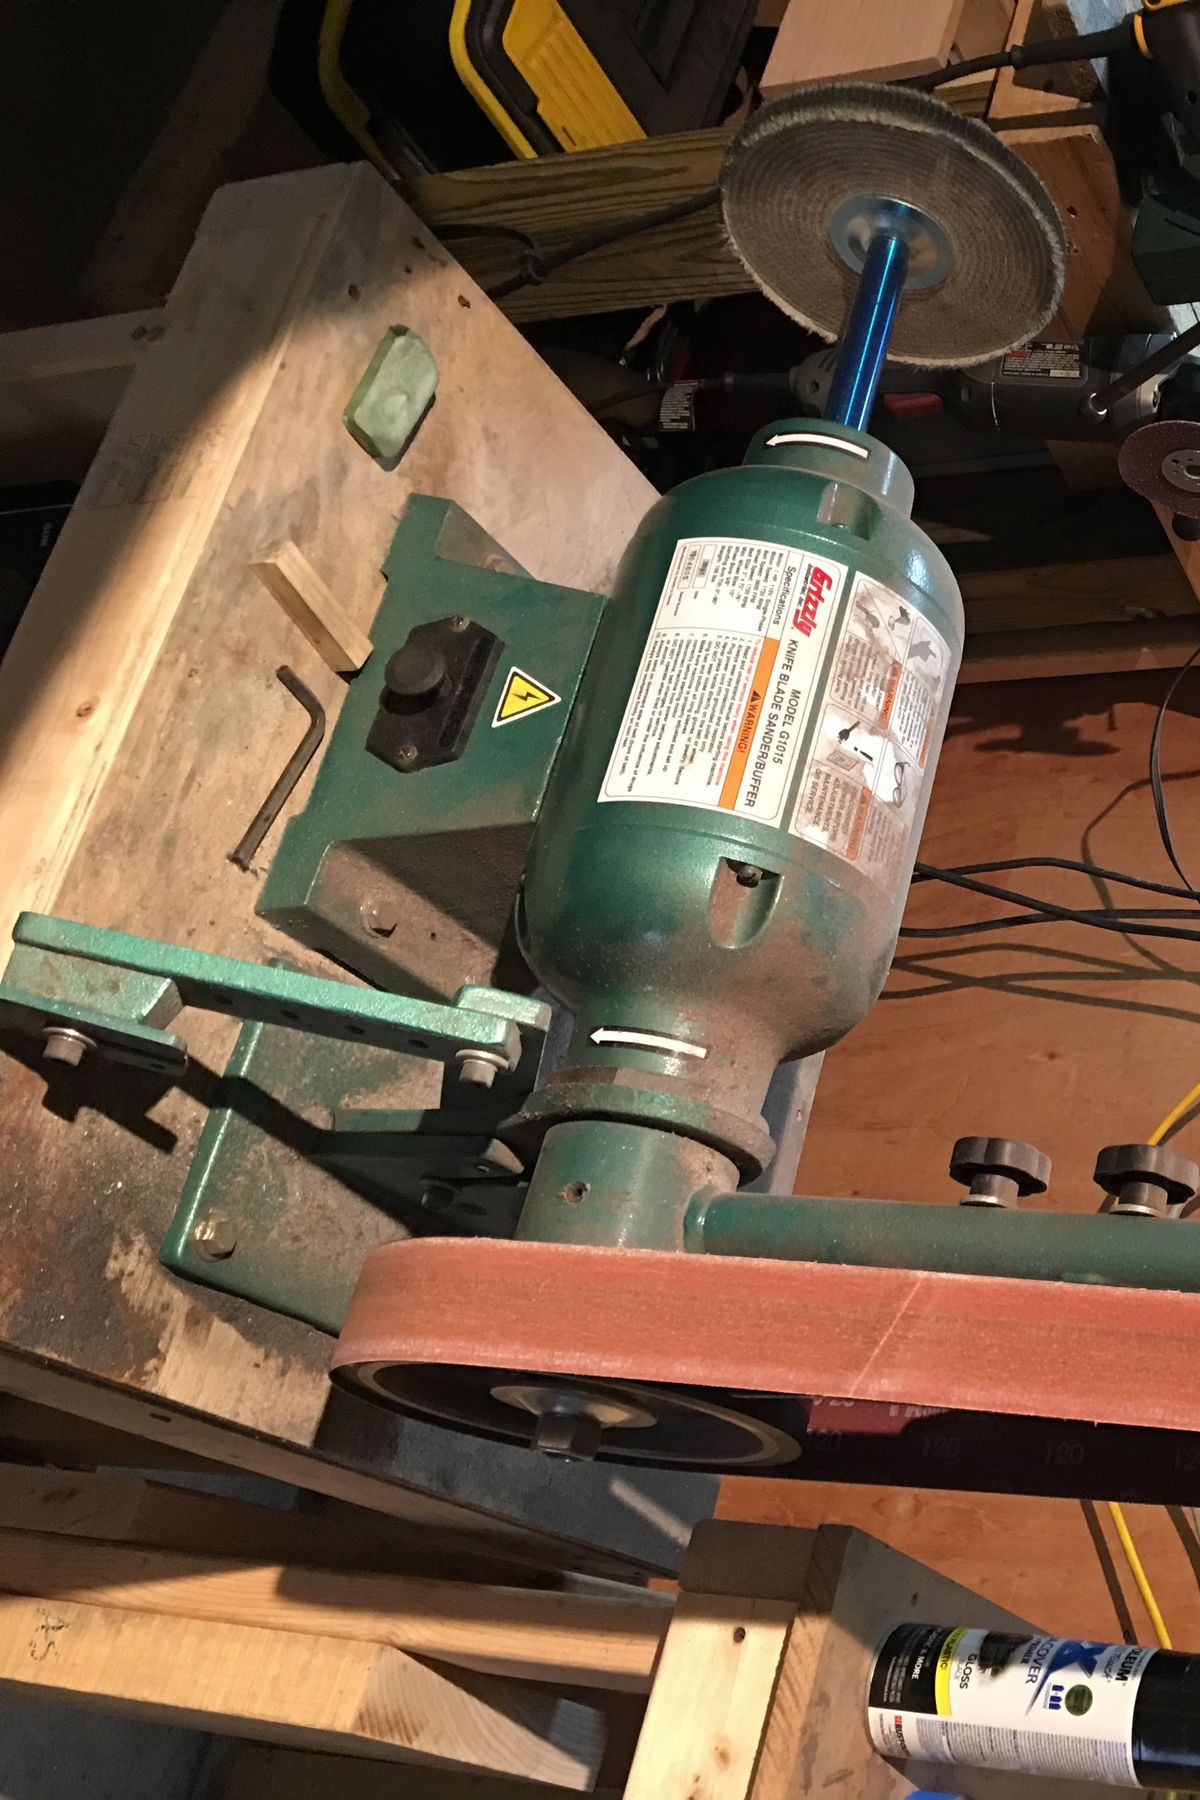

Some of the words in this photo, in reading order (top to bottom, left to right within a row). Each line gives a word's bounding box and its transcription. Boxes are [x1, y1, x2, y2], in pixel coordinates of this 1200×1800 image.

[770, 565, 796, 625] Specifications
[791, 565, 832, 637] Grizzly
[781, 638, 798, 671] KNIFE
[770, 673, 789, 711] BLADE
[781, 688, 801, 727] MODEL
[736, 703, 758, 753] WARNING!
[772, 730, 790, 764] G1015
[744, 712, 779, 807] SANDER/BUFFER
[1045, 1441, 1085, 1466] 120
[912, 1656, 925, 1680] MORE
[960, 1653, 978, 1689] GLOSS
